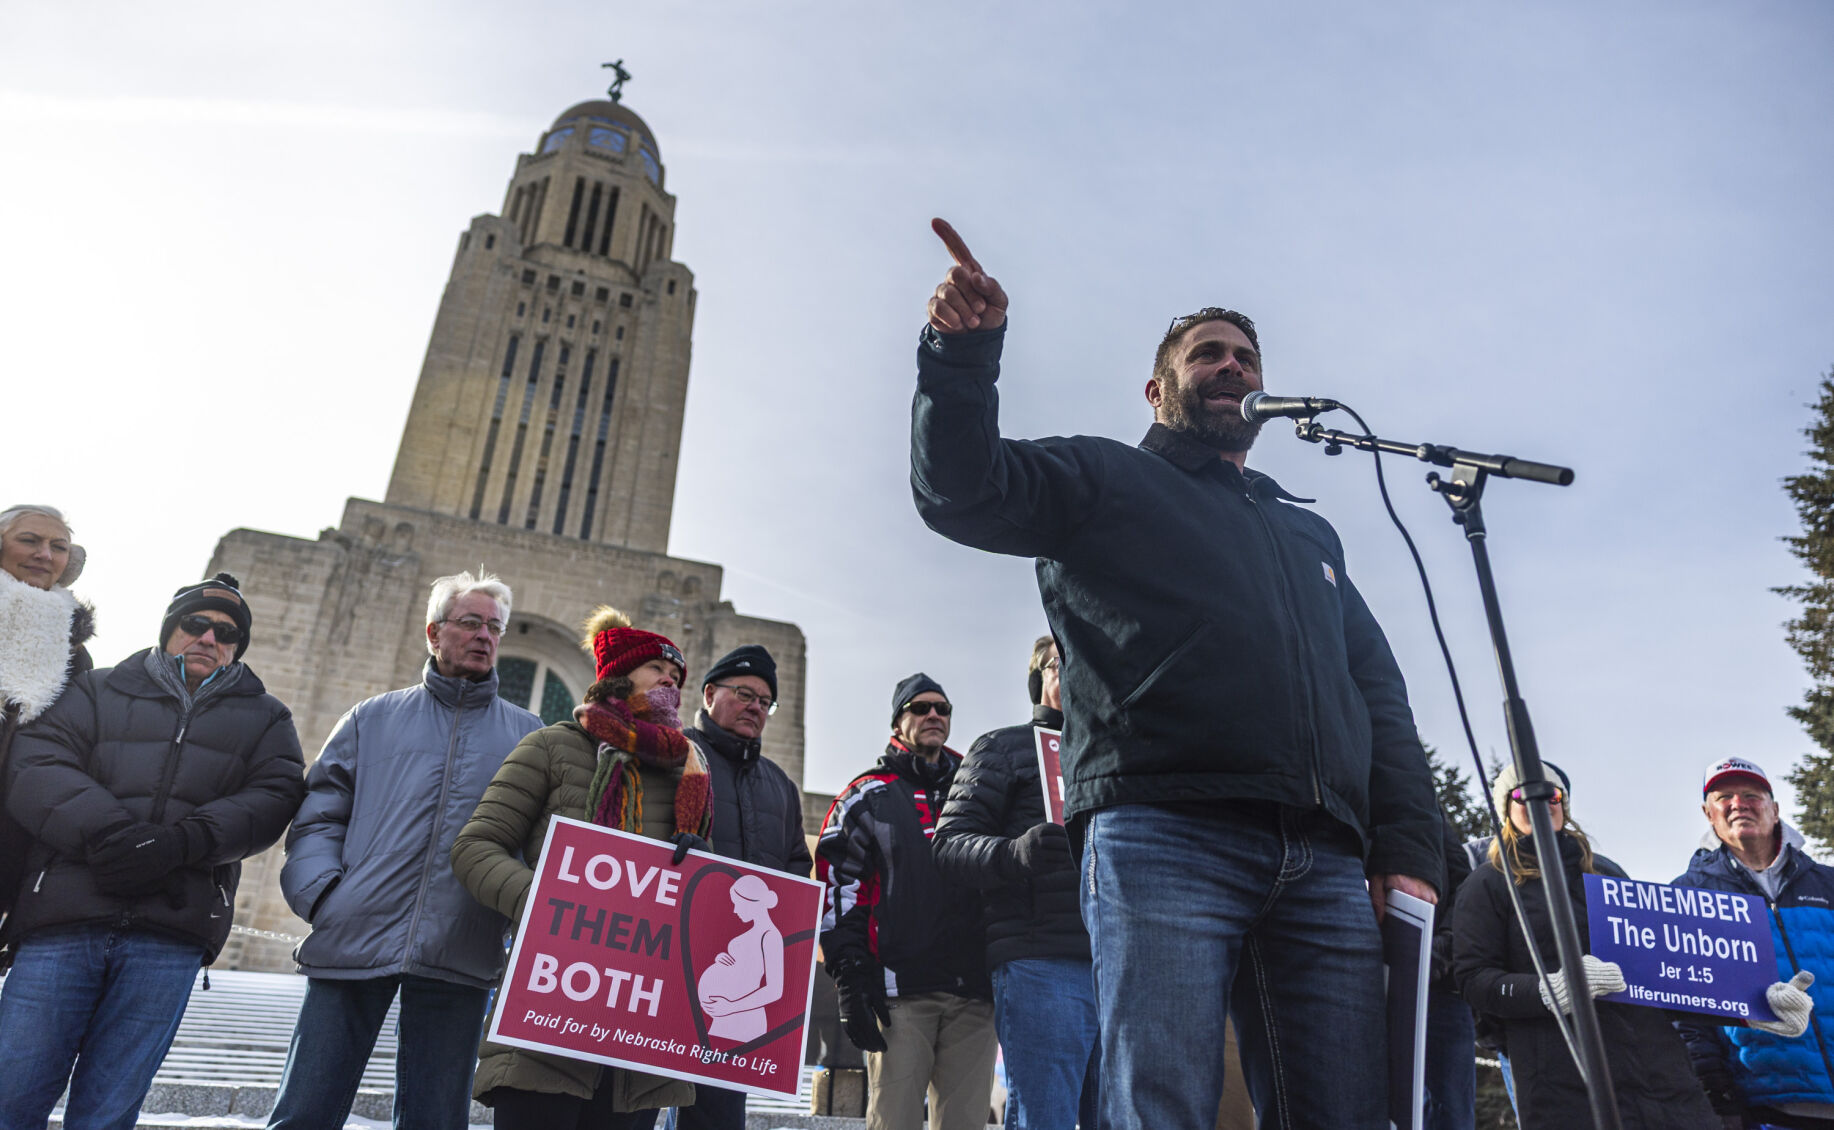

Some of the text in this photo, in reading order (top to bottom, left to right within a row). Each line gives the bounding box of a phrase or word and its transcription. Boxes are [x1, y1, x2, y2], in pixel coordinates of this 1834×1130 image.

[557, 845, 682, 907] LOVE
[1601, 878, 1751, 924] REMEMBER
[548, 897, 673, 961] THEM
[1607, 916, 1758, 963] The Unborn
[526, 952, 664, 1017] BOTH
[1659, 961, 1714, 984] Jer 1:5
[1629, 984, 1750, 1016] liferunners.org
[523, 1010, 778, 1075] Paid for by Nebraska Right to Life
